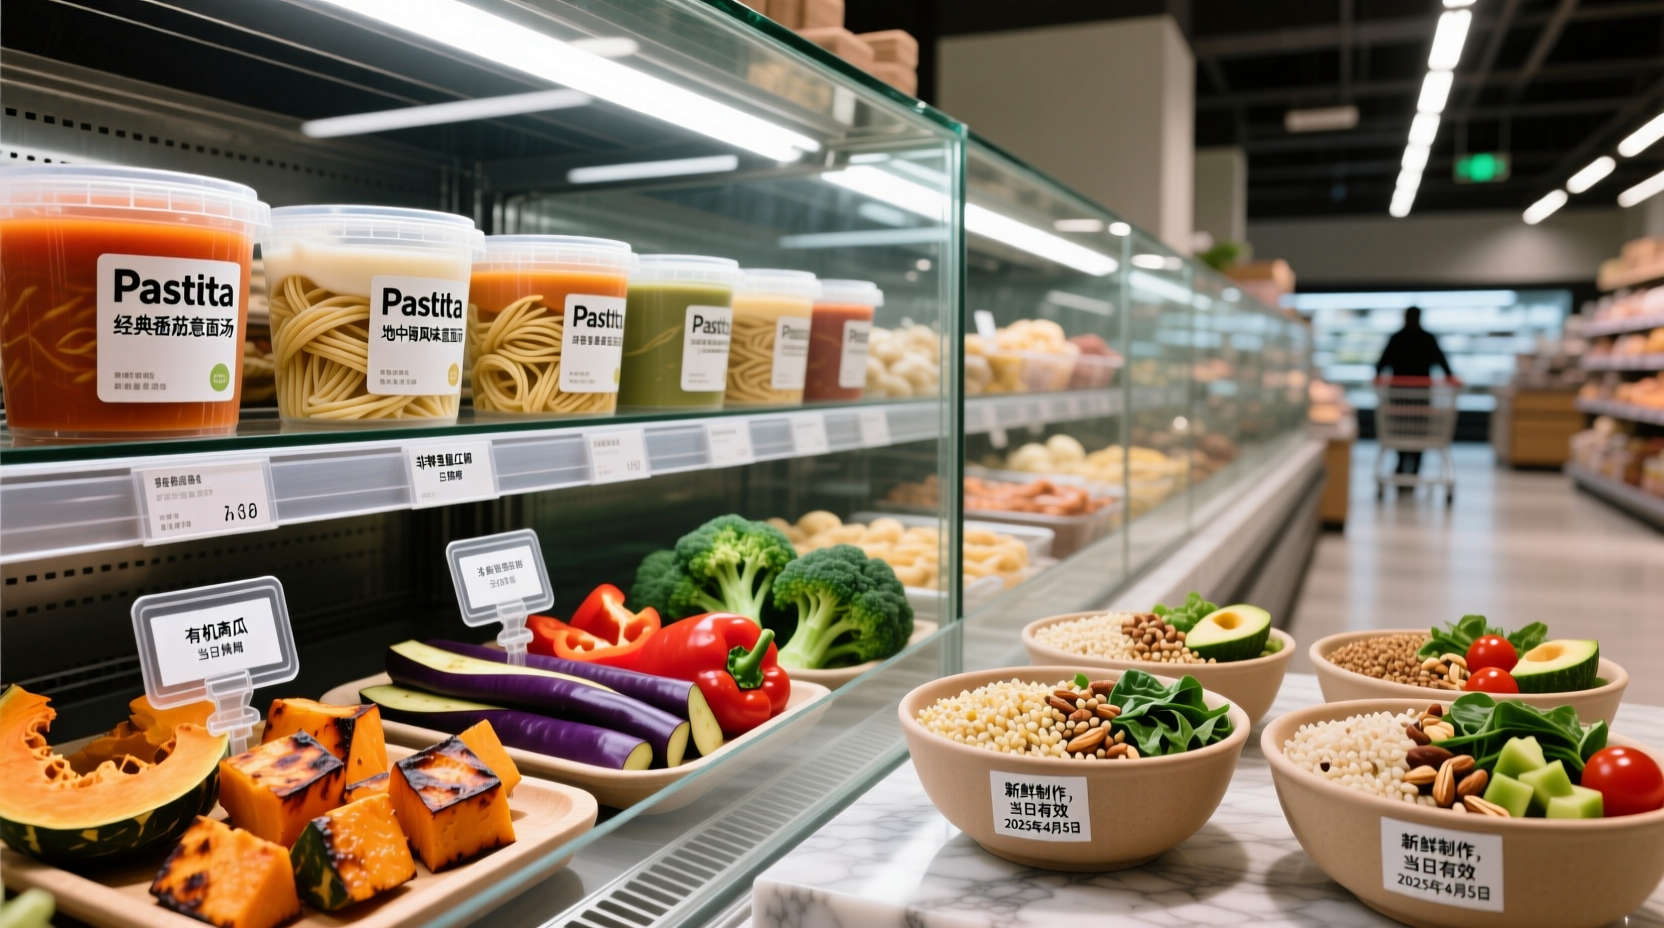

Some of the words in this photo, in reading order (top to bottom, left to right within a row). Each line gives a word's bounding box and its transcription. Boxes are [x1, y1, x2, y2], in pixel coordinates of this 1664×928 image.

[113, 268, 234, 307] Pastita
[382, 287, 463, 319] Pastita
[1010, 801, 1069, 818] 当日有效
[1004, 818, 1081, 835] 2025年4月5日
[1404, 854, 1476, 881] 当日有效
[1397, 873, 1490, 901] 2025年4月5日
